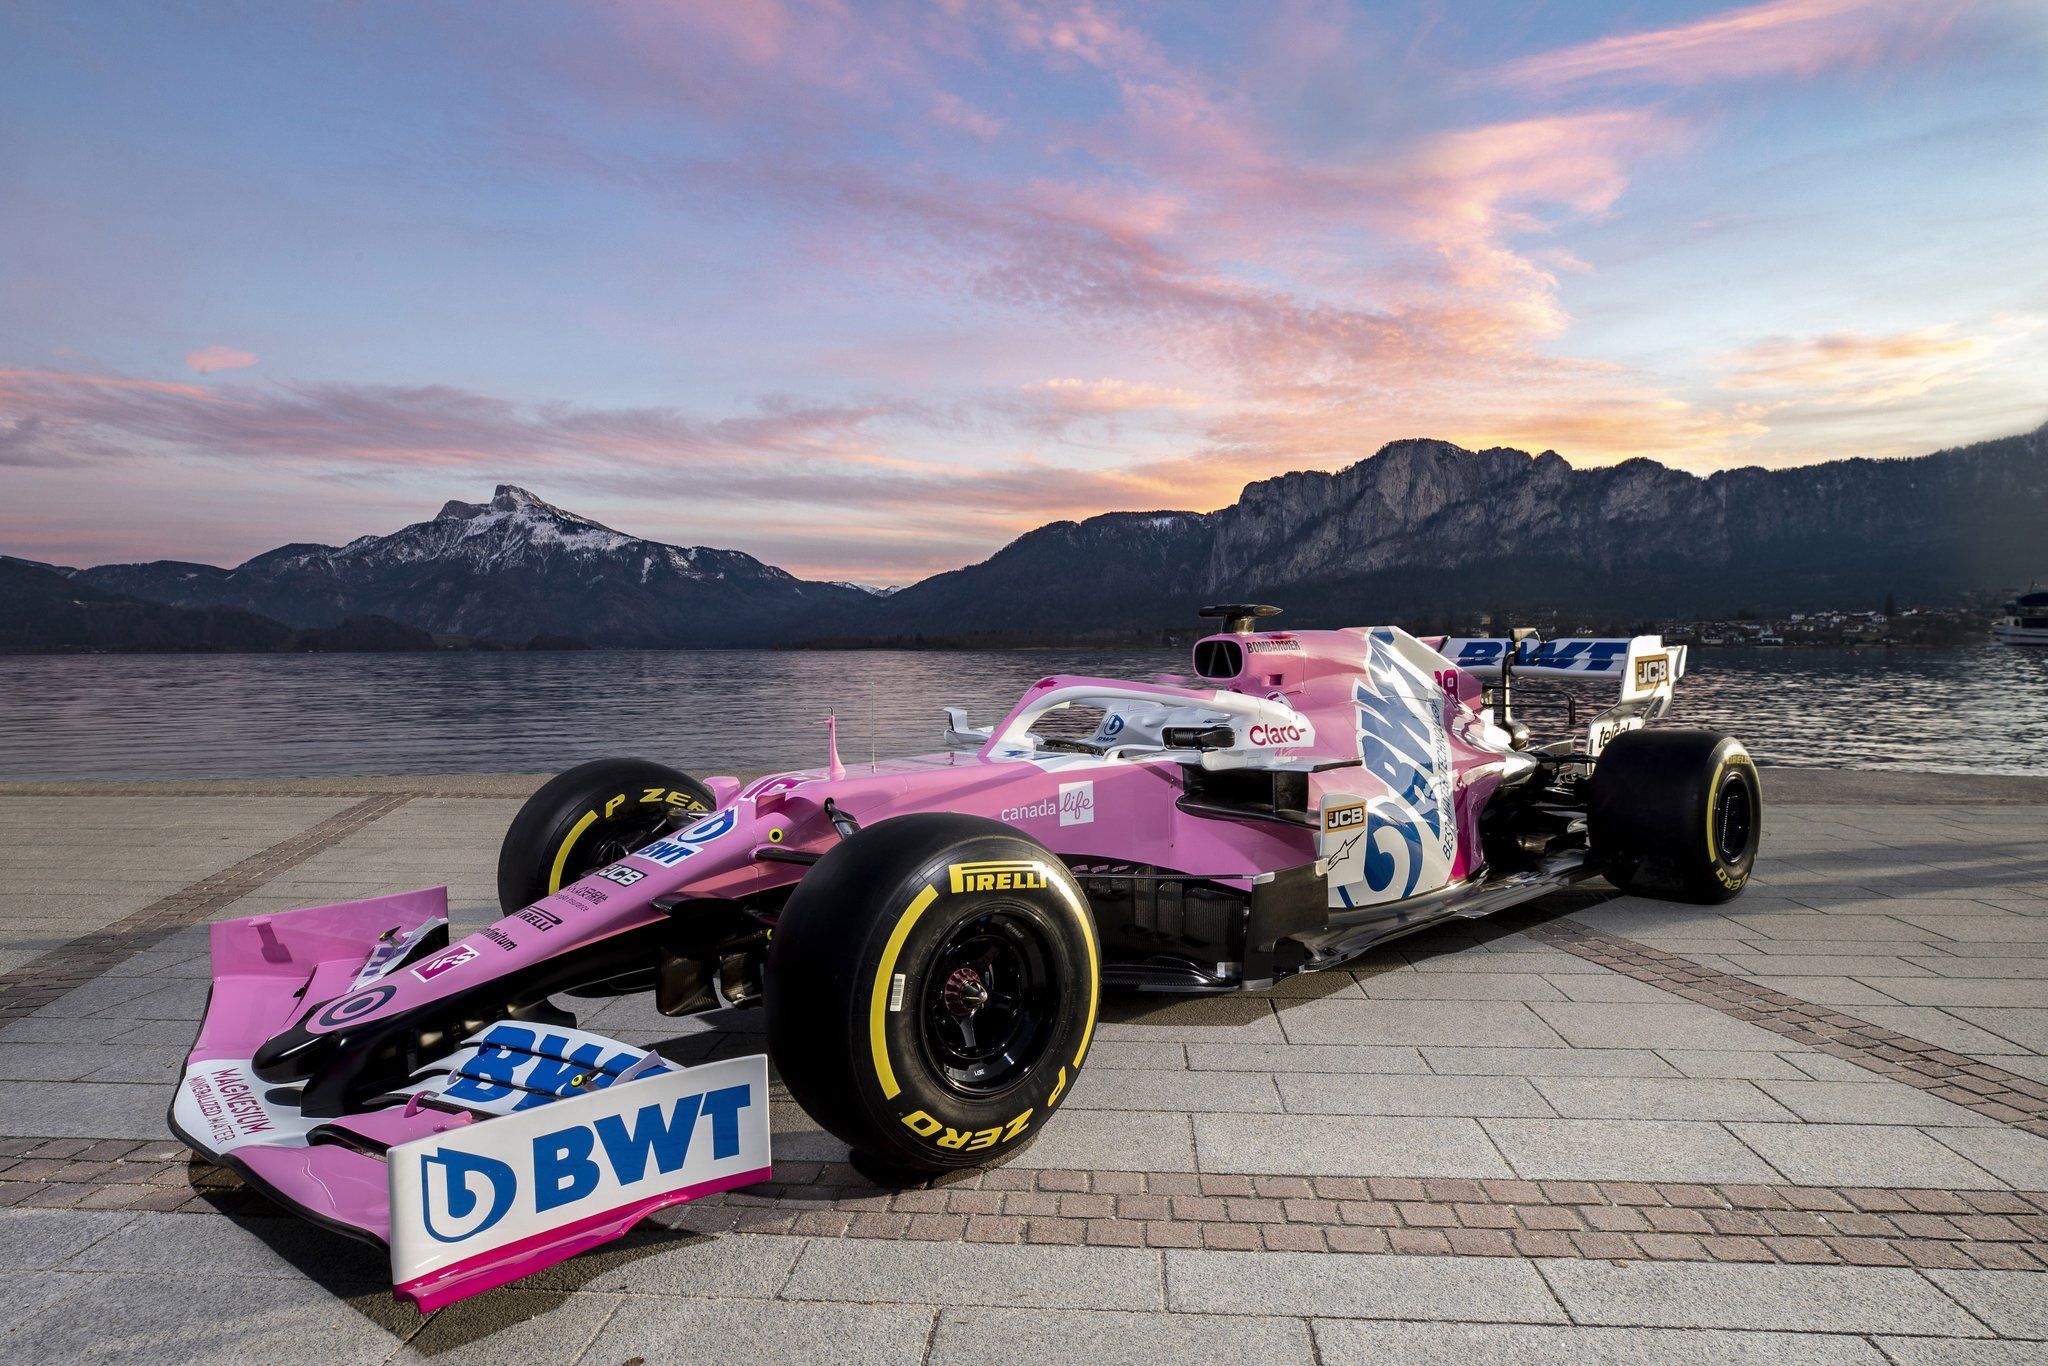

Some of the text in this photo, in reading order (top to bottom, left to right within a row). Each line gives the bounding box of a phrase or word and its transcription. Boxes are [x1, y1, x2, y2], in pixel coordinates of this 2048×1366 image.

[1245, 640, 1301, 653] BOMBARDIER
[1456, 641, 1628, 671] BWT
[1638, 660, 1667, 684] JCB
[1357, 626, 1440, 840] BWT
[606, 788, 708, 819] P ZER
[1001, 791, 1094, 821] canada life
[1327, 806, 1365, 829] JCB
[636, 841, 696, 864] BWT
[598, 864, 644, 886] JCB
[949, 860, 1047, 894] PIRELLI
[426, 951, 476, 972] IFS
[443, 1026, 673, 1111] BW
[211, 1067, 276, 1136] MAGNESIUM
[901, 1066, 1067, 1152] P ZERO
[207, 1114, 236, 1145] WATER
[533, 1084, 751, 1213] BWT
